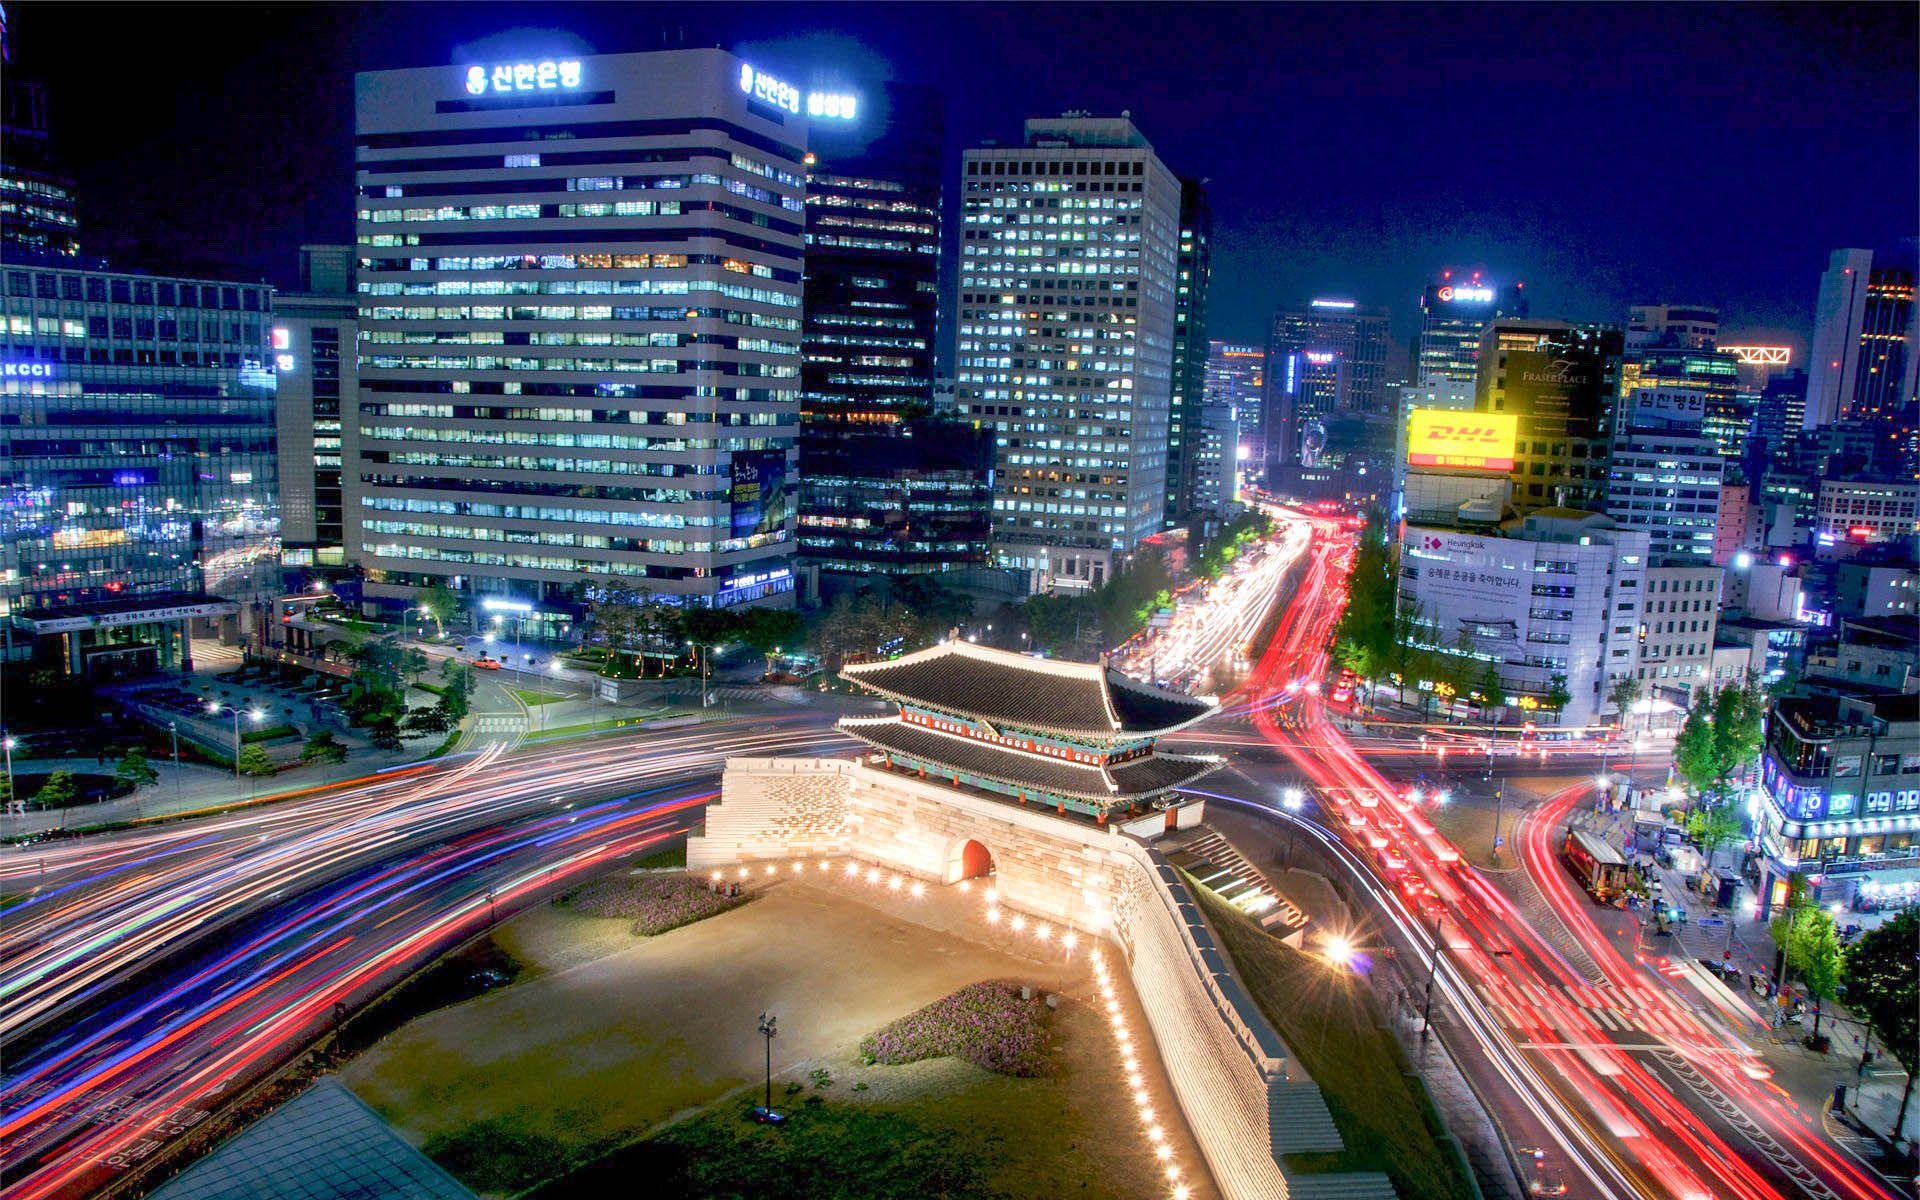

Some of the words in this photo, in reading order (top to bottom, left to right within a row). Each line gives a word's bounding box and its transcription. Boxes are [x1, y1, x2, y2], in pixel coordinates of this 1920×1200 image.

[492, 61, 581, 91] 신한은행
[755, 72, 799, 114] 신한은행
[1641, 392, 1701, 411] 힘찬병원
[1428, 426, 1499, 442] DHL
[1447, 538, 1485, 550] Heungkuk
[1428, 567, 1451, 580] 숭례문
[1453, 571, 1476, 583] 준공을
[1418, 679, 1433, 691] KB
